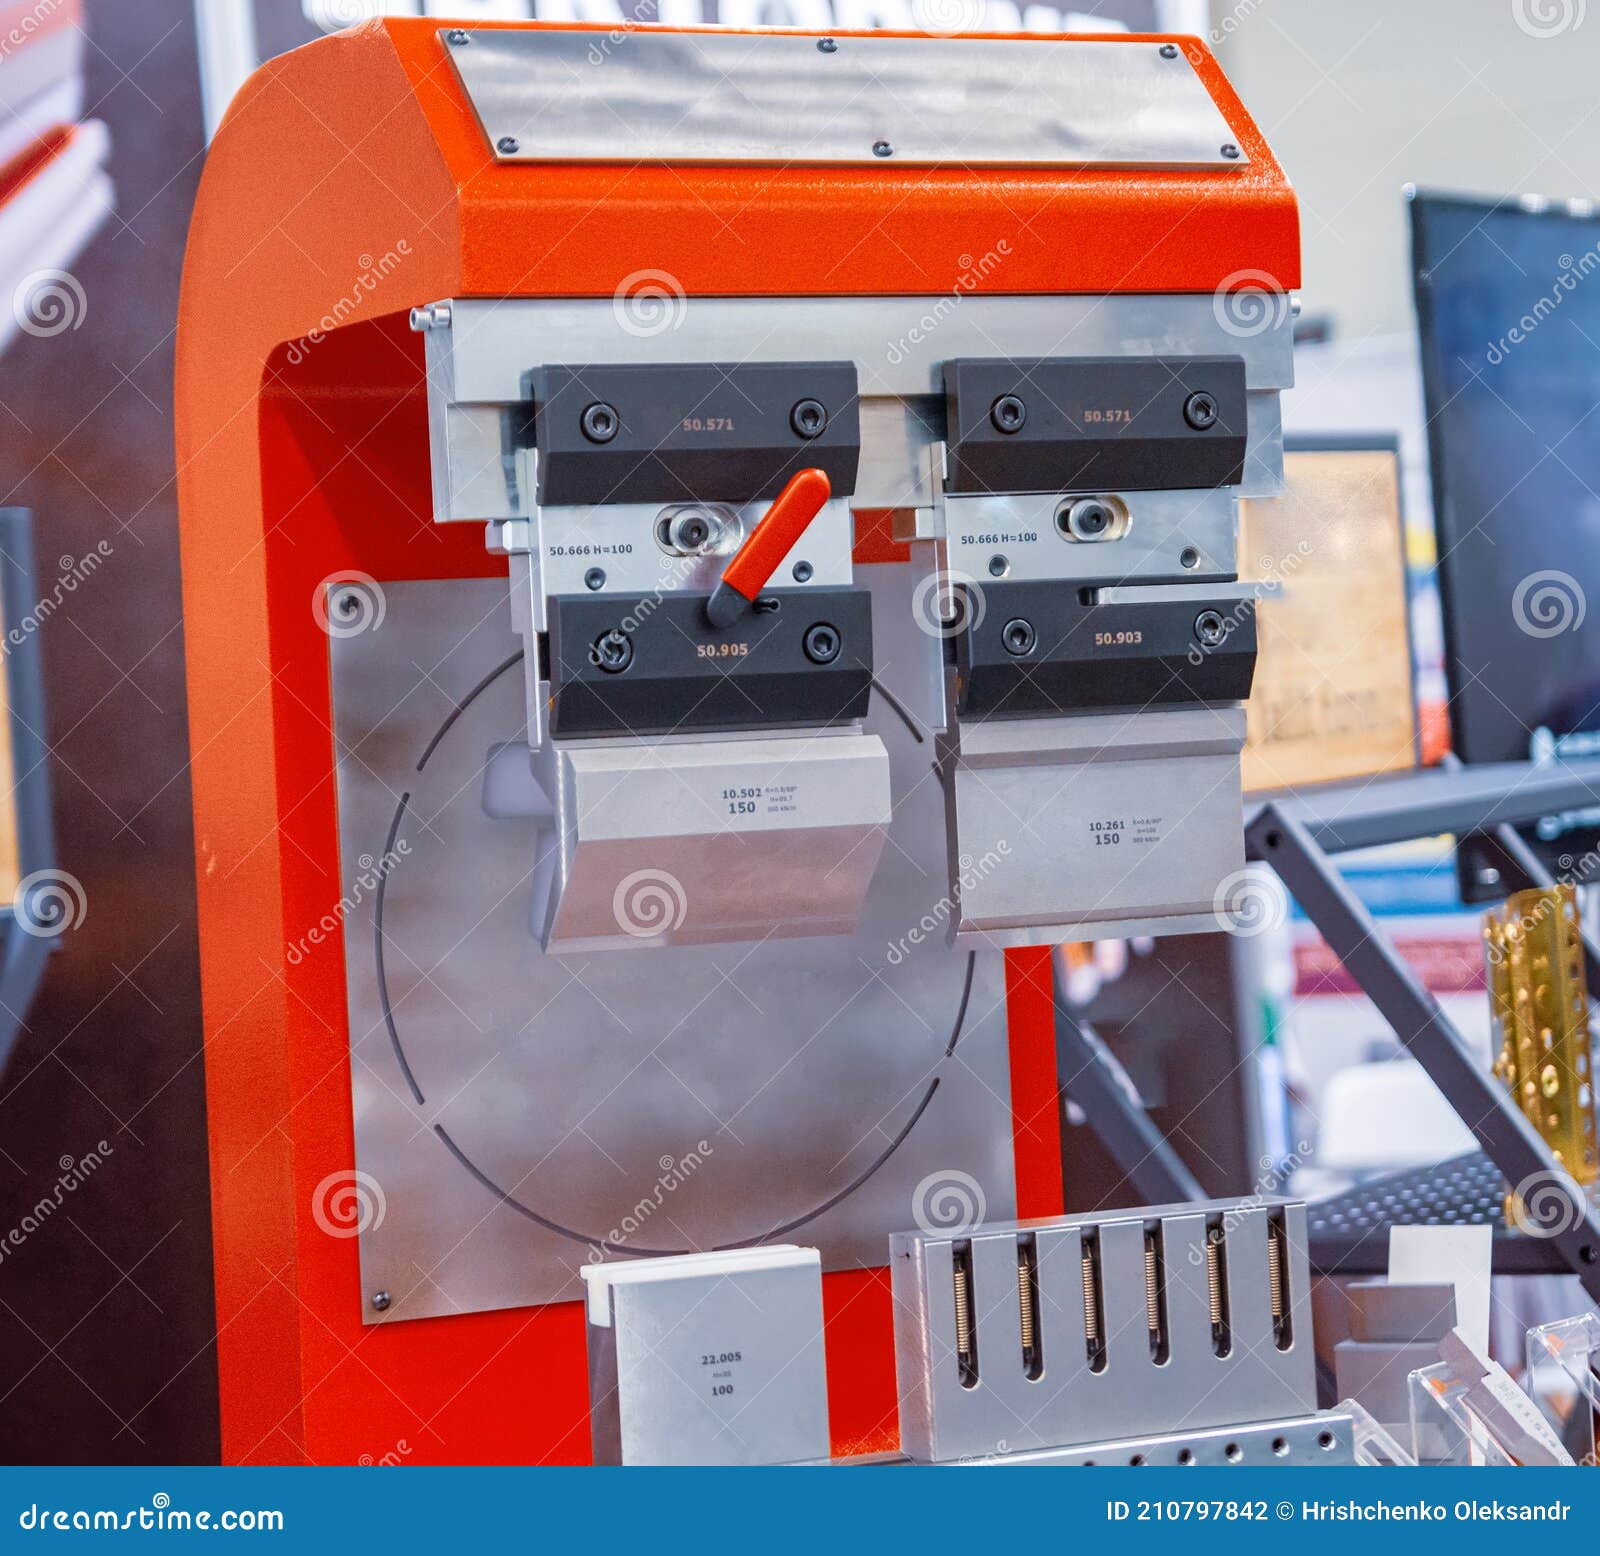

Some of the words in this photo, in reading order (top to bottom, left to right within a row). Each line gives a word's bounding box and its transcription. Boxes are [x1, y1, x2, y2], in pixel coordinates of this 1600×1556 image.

[1084, 410, 1132, 422] 50.571
[683, 418, 734, 431] 50.571
[961, 535, 999, 545] 50.666
[1001, 532, 1038, 543] H=100
[549, 546, 591, 556] 50.666
[593, 544, 633, 554] H=100
[1095, 632, 1142, 645] 50.903
[697, 644, 749, 657] 50.905
[722, 788, 762, 799] 10.502
[729, 801, 756, 814] 150
[1089, 821, 1125, 831] 10.261
[1095, 833, 1120, 845] 150
[701, 1352, 742, 1365] 22.005
[712, 1384, 734, 1396] 100
